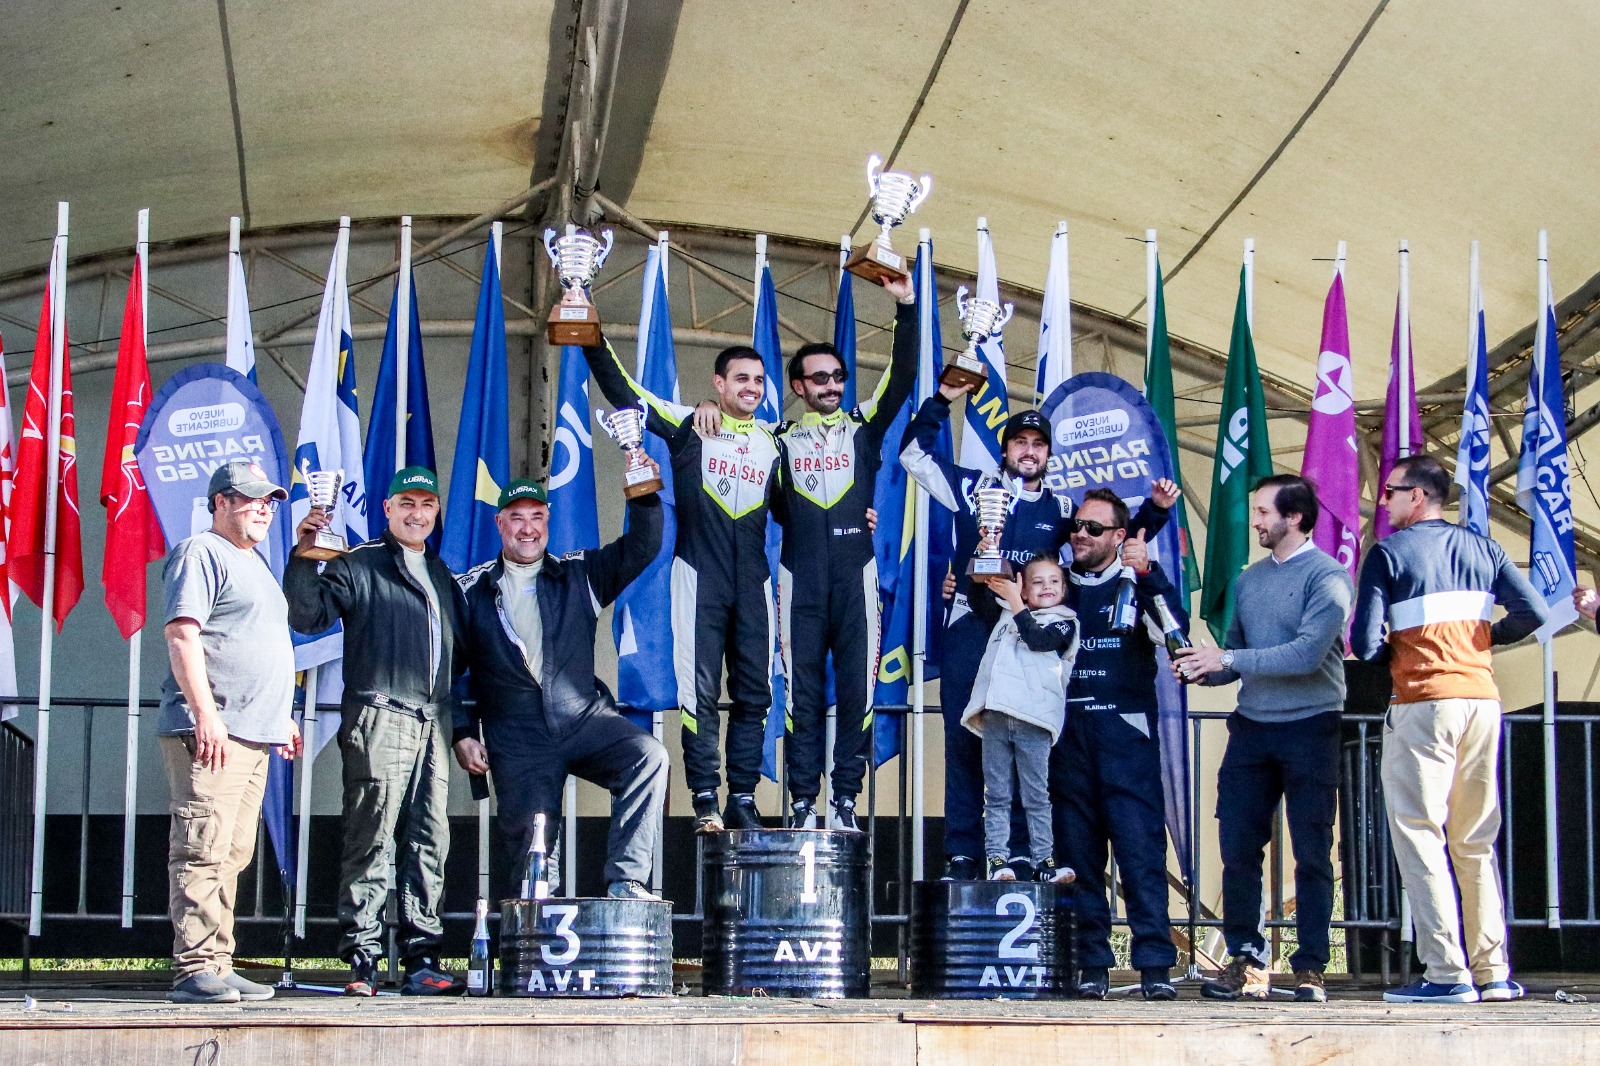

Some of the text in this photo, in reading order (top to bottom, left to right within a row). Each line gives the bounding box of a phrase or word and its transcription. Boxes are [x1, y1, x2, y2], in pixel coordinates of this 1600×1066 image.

[708, 457, 765, 486] BRASAS
[794, 454, 850, 472] BRASAS
[403, 475, 434, 487] LUBRAX
[508, 485, 539, 497] LUBRAX
[1536, 465, 1574, 536] CAR
[798, 841, 818, 903] 1
[540, 904, 580, 965] 3
[995, 892, 1039, 959] 2
[526, 969, 600, 992] A.V.T.
[978, 965, 1050, 987] A.V.T.
